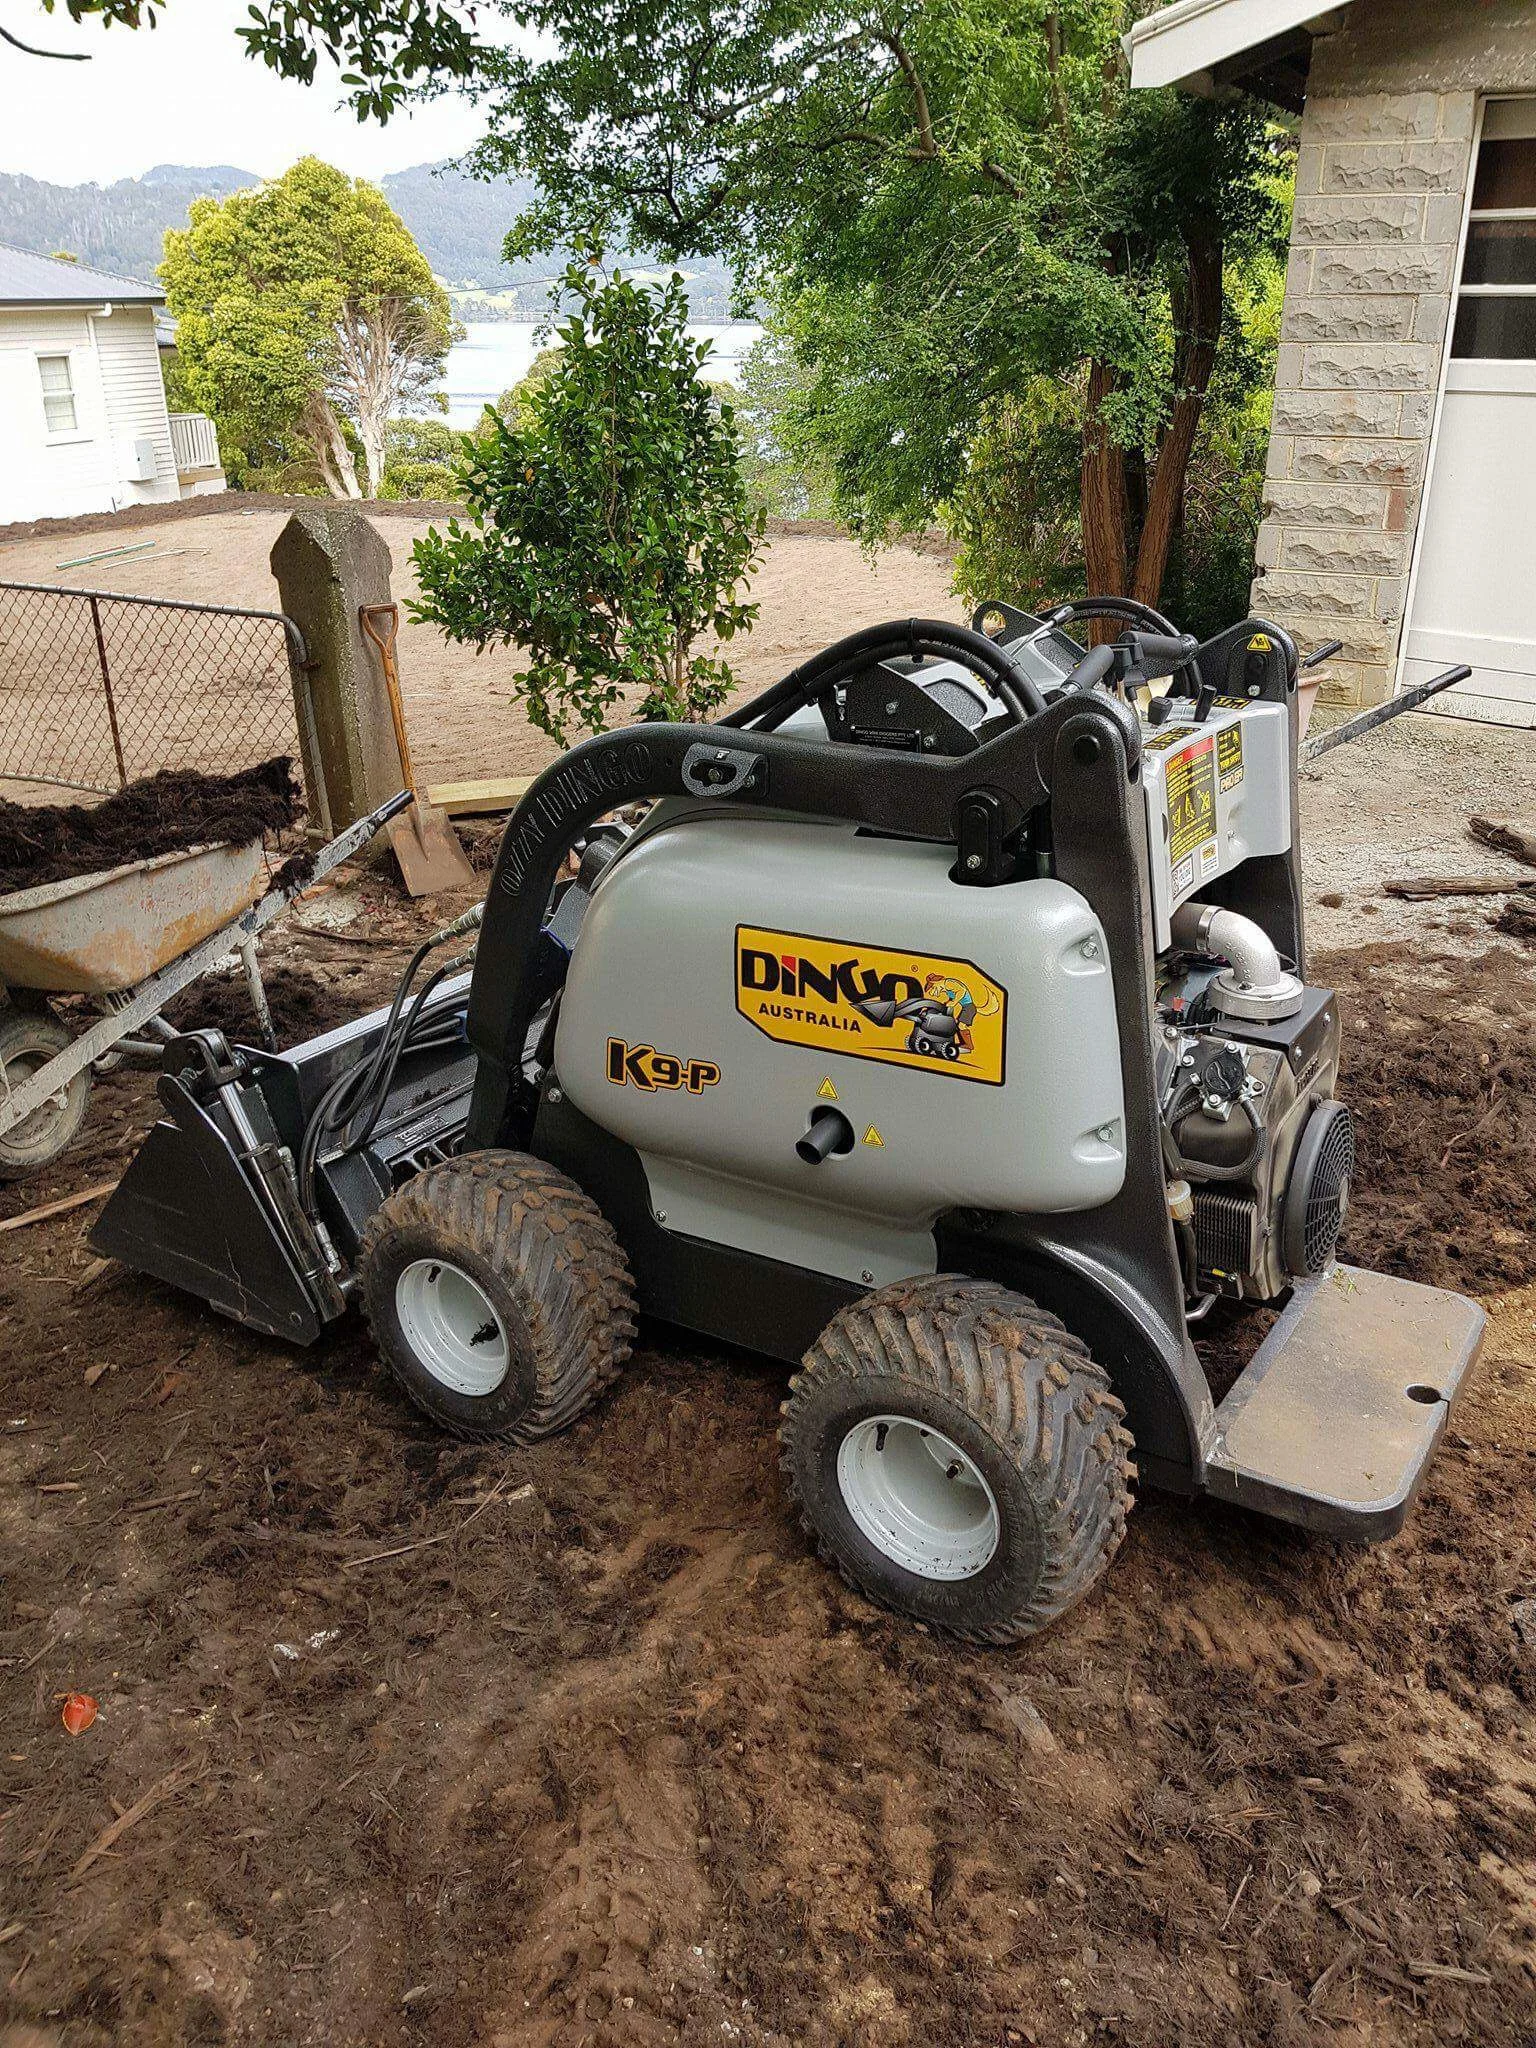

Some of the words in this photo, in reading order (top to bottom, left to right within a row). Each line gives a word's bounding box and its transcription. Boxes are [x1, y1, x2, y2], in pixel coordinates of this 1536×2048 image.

[537, 741, 652, 828] DINGO
[758, 1002, 863, 1034] AUSTRALIA
[606, 1036, 721, 1095] K9-P
